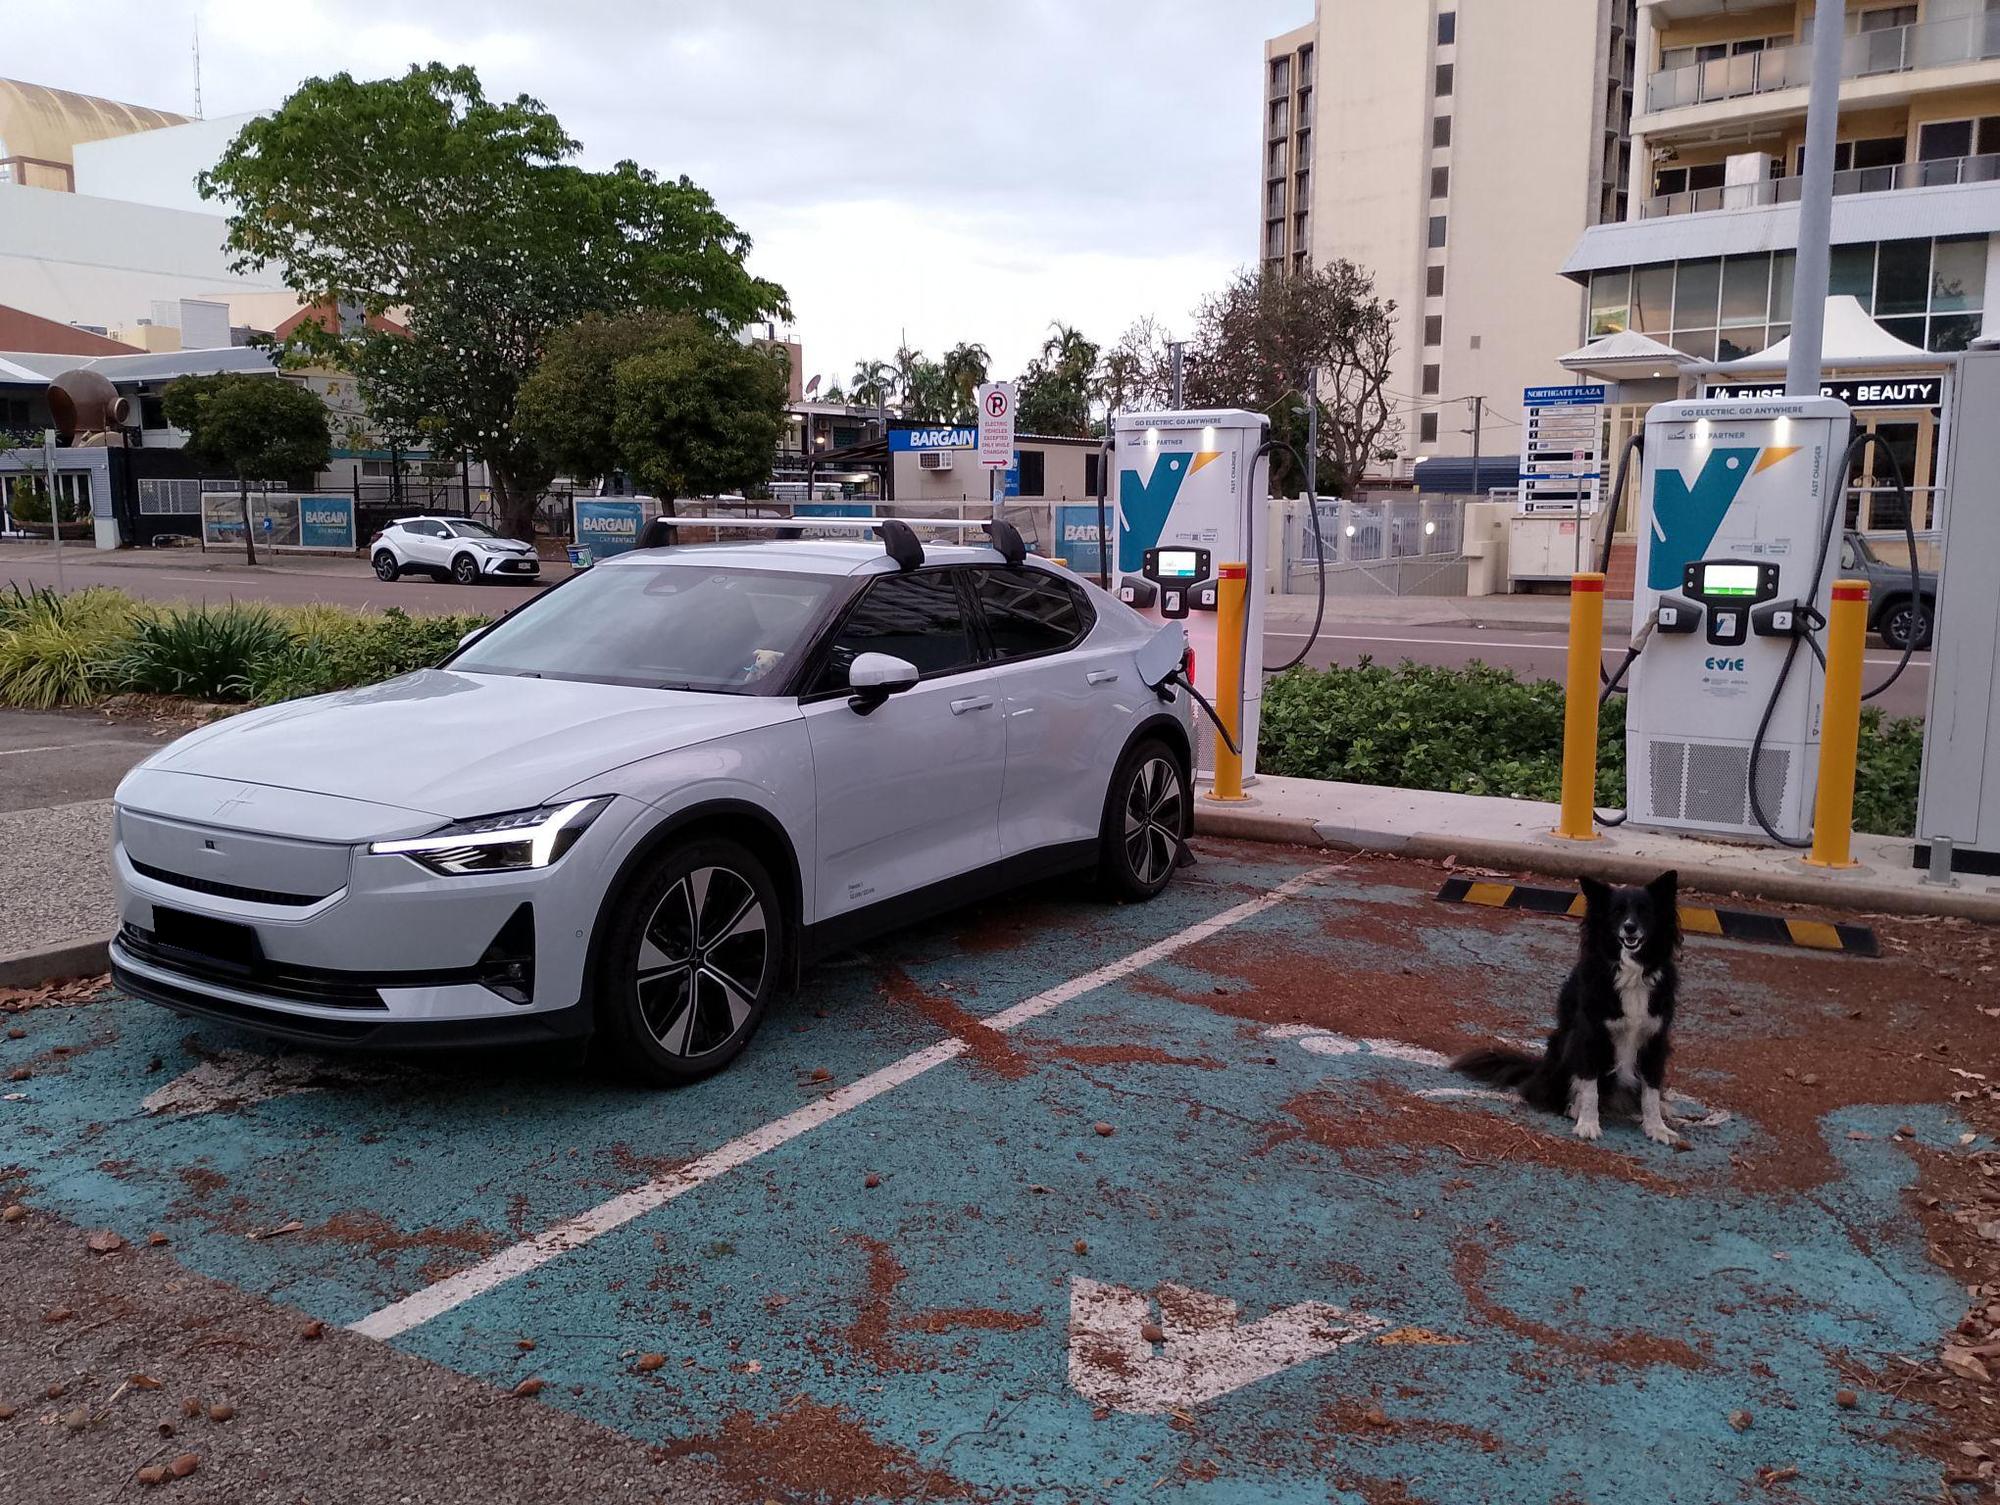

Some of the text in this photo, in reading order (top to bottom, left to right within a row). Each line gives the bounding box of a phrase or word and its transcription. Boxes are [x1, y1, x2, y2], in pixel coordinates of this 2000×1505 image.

[1527, 388, 1601, 398] NORTHGATE PLAZA
[1857, 384, 1932, 401] BEAUTY
[1681, 409, 1694, 417] GO
[1739, 407, 1752, 415] GO
[1753, 406, 1804, 415] ANYWHERE
[1134, 419, 1145, 427] GO
[1176, 418, 1185, 426] GO
[1186, 417, 1222, 425] ANYWHERE
[909, 430, 976, 448] BARGAIN
[1811, 445, 1821, 497] FAST CHARGER
[305, 511, 347, 525] BARGAIN
[583, 517, 637, 533] BARGAIN
[1205, 593, 1211, 601] 2
[1665, 612, 1670, 621] 1
[1779, 616, 1786, 625] 2
